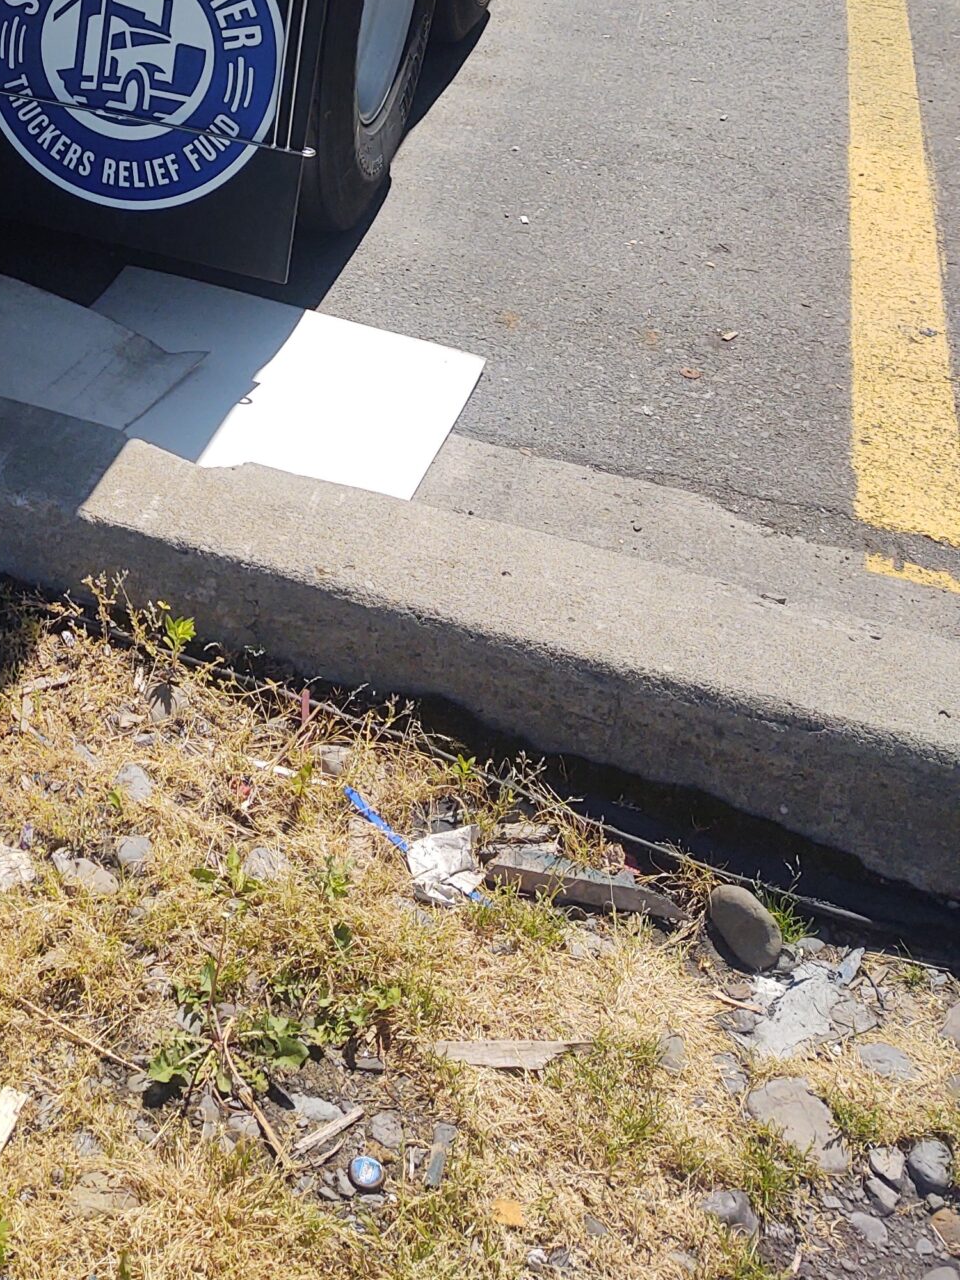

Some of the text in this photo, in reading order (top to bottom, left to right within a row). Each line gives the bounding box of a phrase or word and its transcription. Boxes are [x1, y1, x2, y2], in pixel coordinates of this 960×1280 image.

[4, 73, 240, 188] TRUCKERS RELIEF FUND
